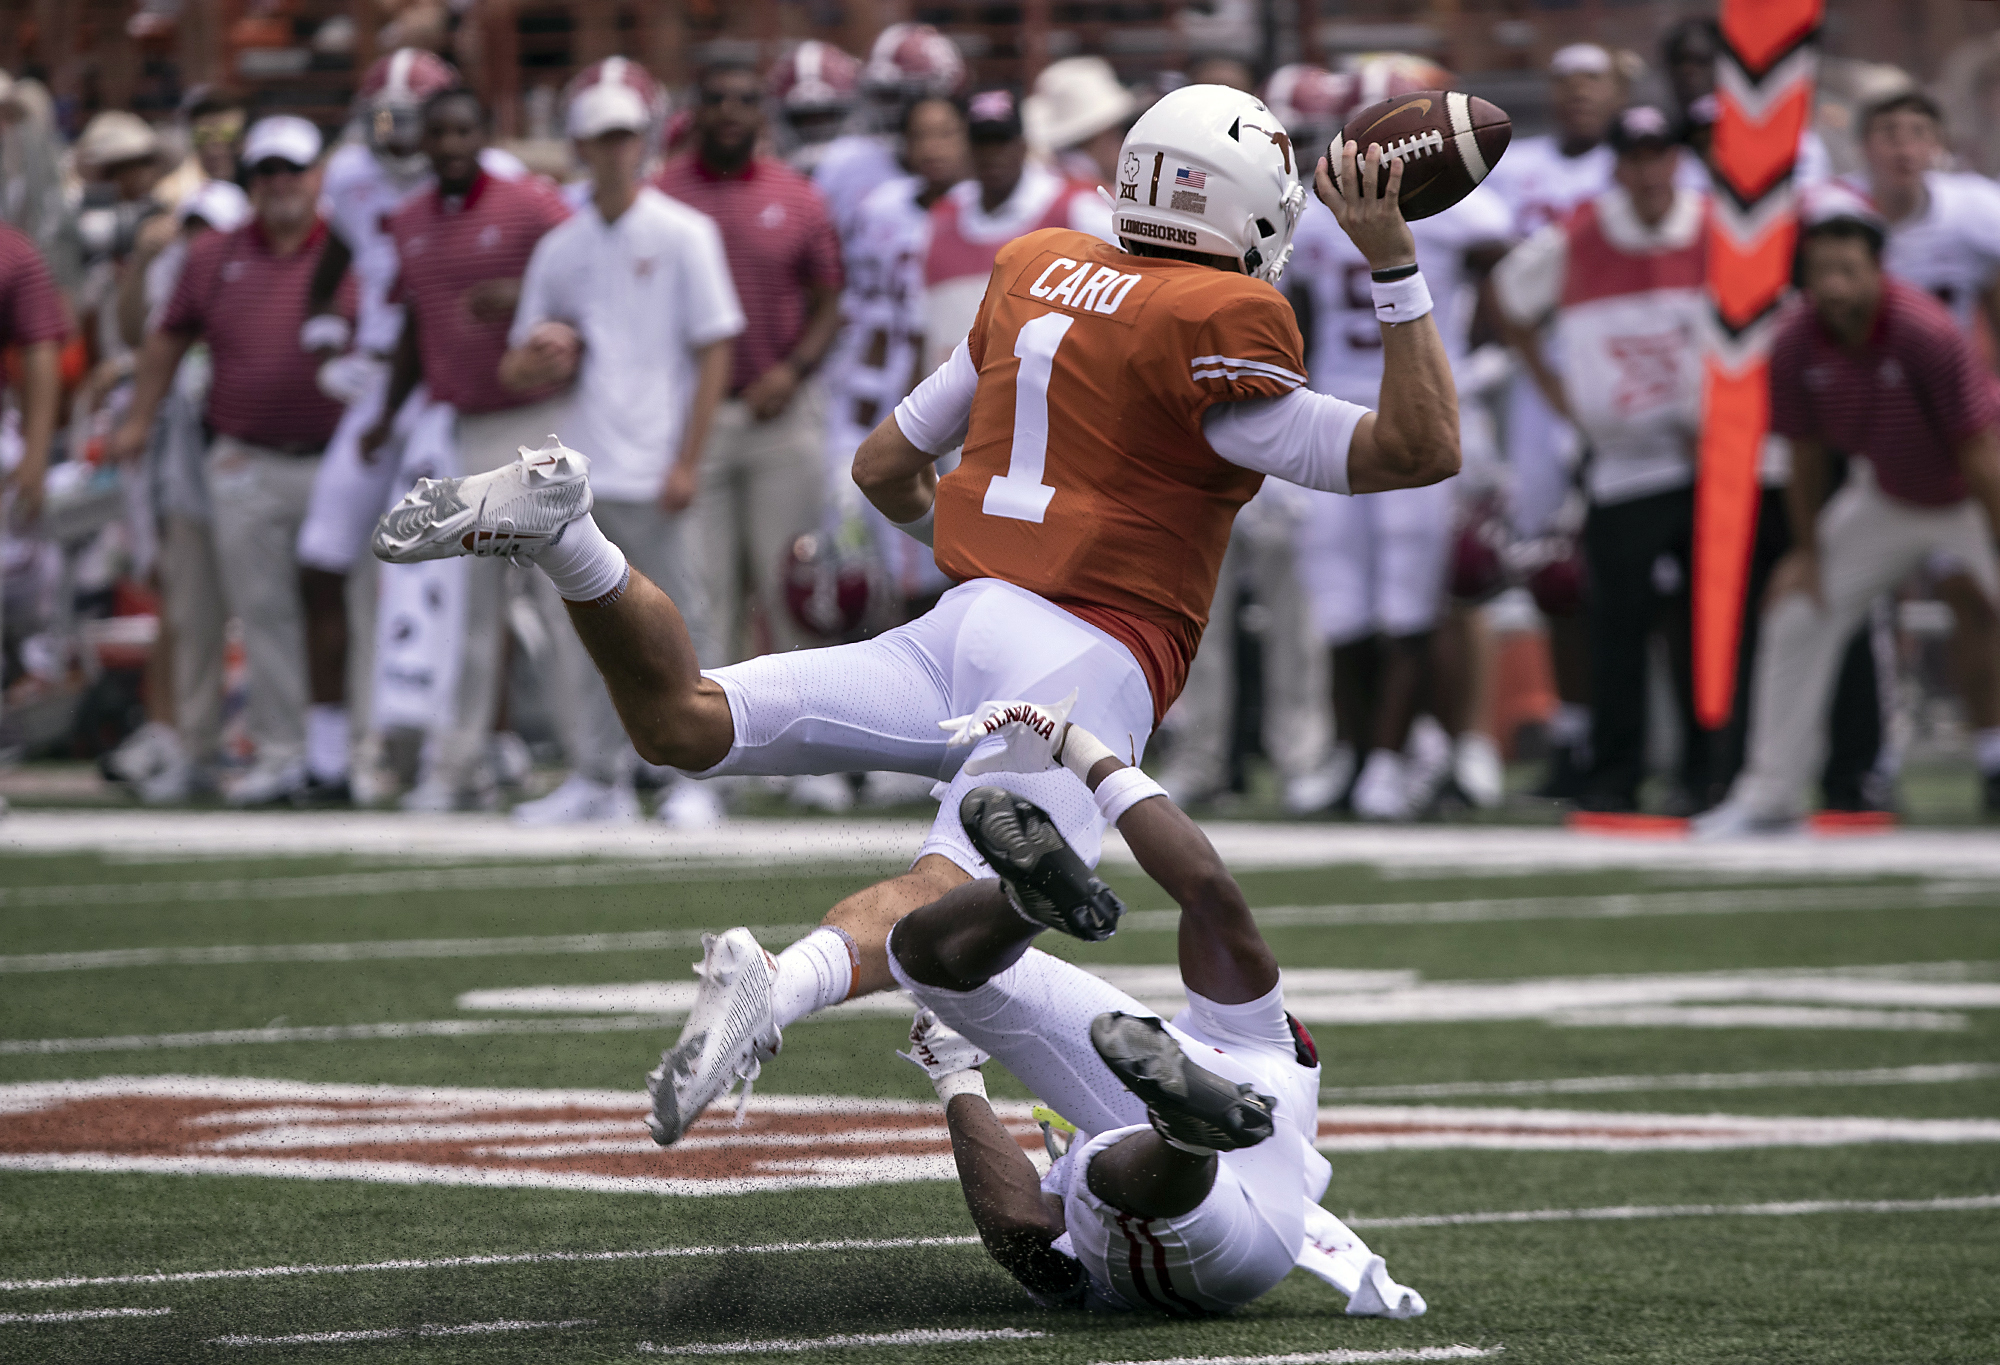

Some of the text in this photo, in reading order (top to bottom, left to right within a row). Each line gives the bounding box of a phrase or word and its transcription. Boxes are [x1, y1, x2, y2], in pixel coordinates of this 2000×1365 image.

[1149, 151, 1164, 207] 1
[1120, 218, 1197, 246] LONGHORNS
[1029, 257, 1142, 315] CARD
[982, 311, 1075, 523] 1
[982, 704, 1056, 741] ALABAMA
